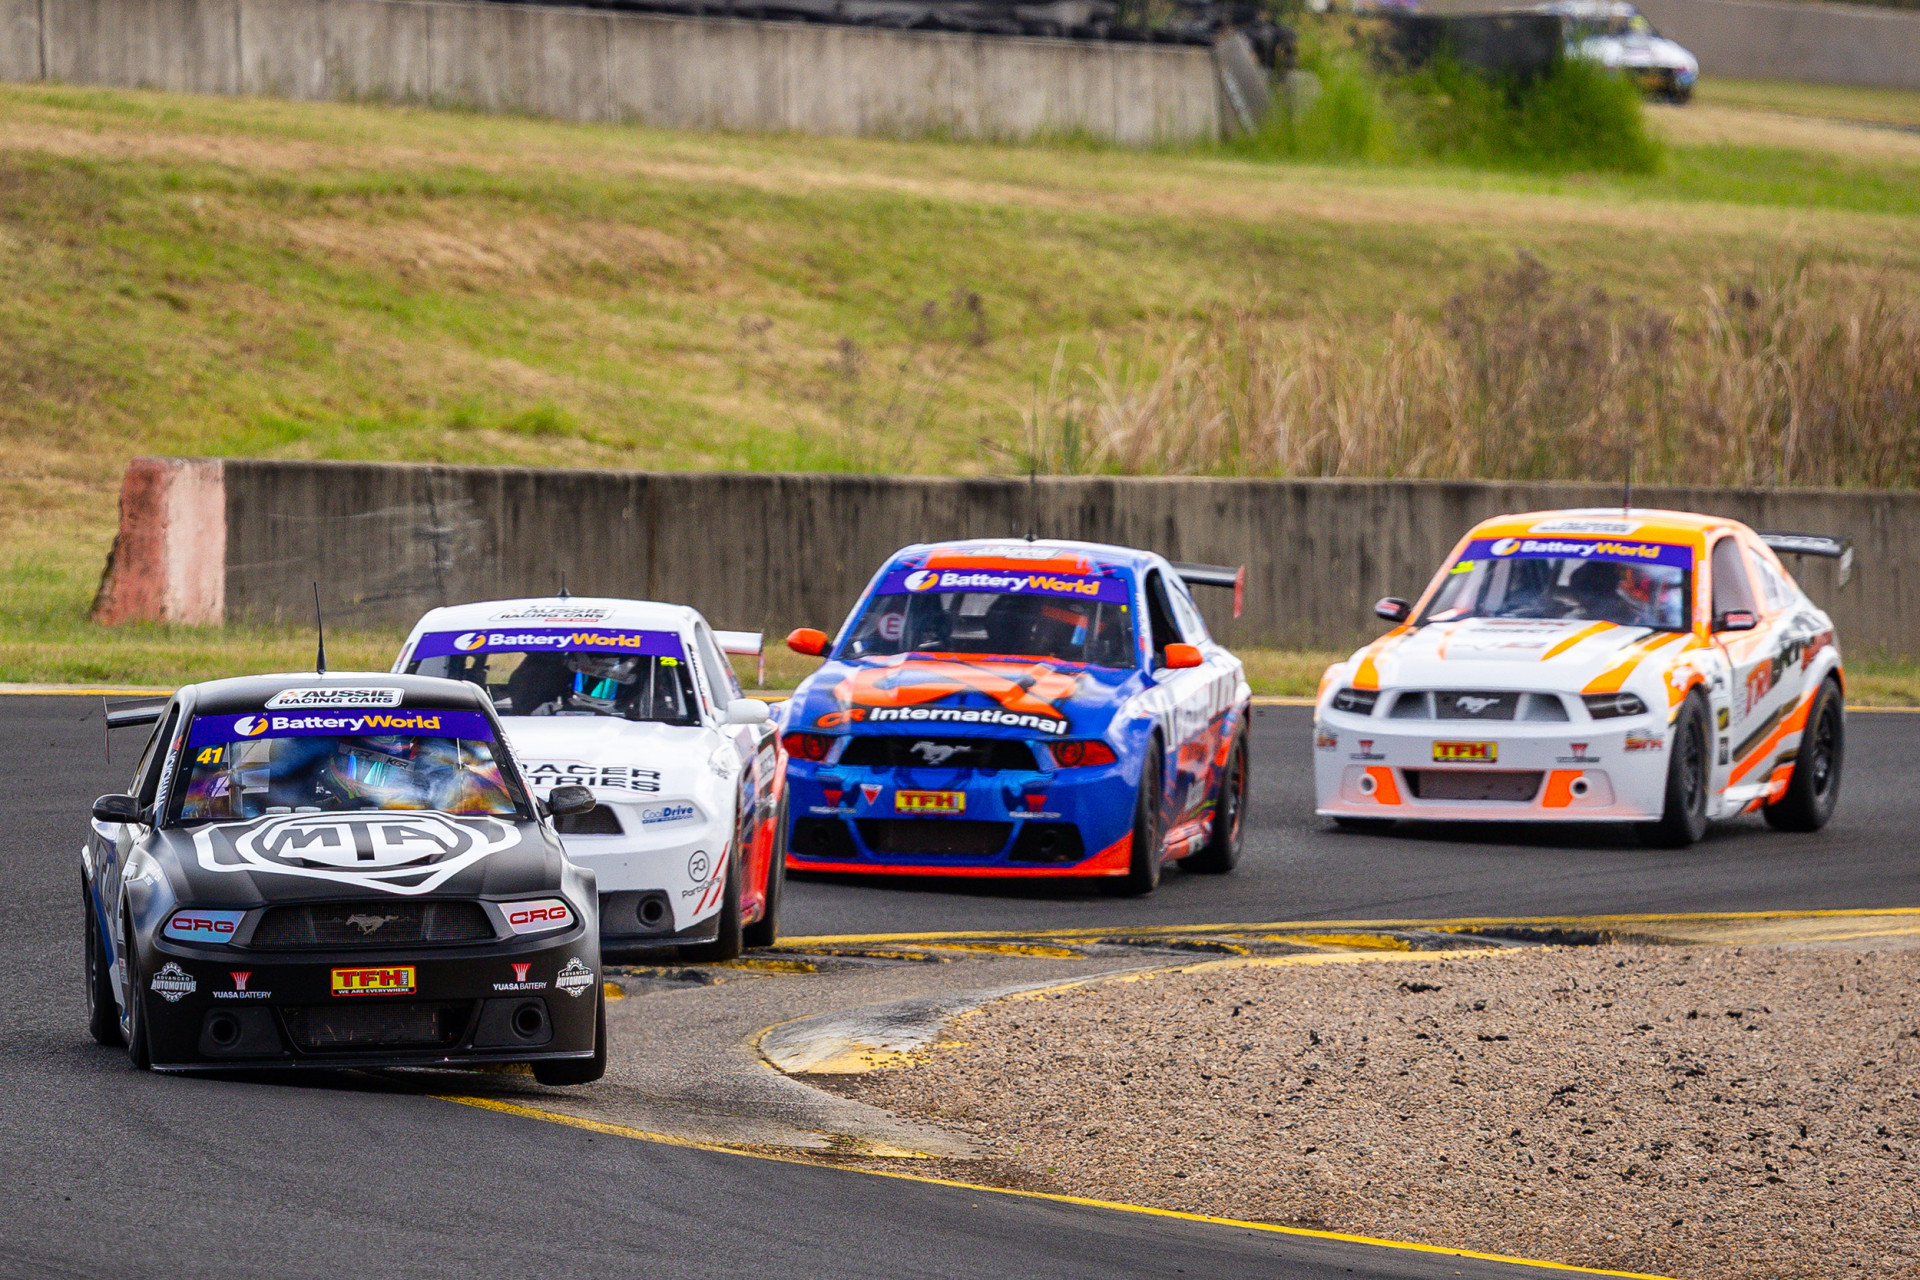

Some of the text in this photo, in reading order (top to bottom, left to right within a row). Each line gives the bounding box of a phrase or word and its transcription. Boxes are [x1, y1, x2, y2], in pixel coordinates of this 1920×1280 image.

[1521, 540, 1660, 558] BatteryWorld
[939, 572, 1100, 596] BatteryWorld
[487, 633, 641, 648] BatteryWorld
[279, 696, 393, 705] RACING CARS
[303, 688, 394, 698] AUSSIE
[272, 714, 441, 731] BatteryWorld
[869, 707, 1068, 735] International
[196, 747, 223, 765] 41
[522, 764, 661, 780] ACER
[901, 794, 955, 807] TFH
[509, 905, 567, 925] CRG
[172, 917, 235, 933] CRG
[150, 980, 197, 992] AUTOMOTIVE
[336, 969, 402, 987] TFH
[493, 981, 547, 991] YUASA BATTERY
